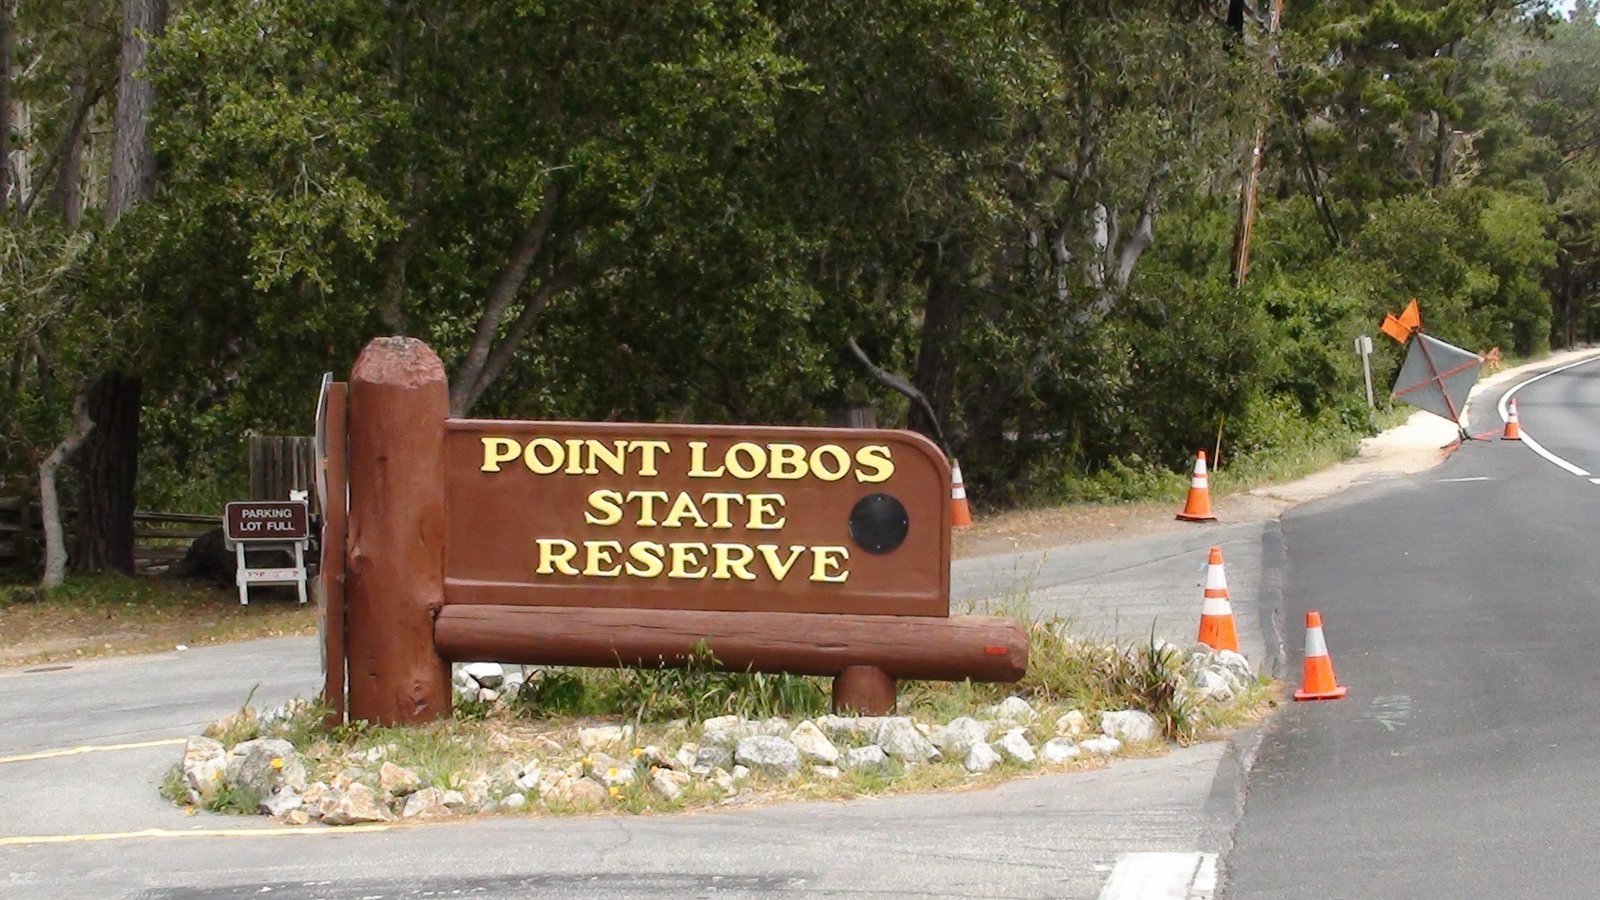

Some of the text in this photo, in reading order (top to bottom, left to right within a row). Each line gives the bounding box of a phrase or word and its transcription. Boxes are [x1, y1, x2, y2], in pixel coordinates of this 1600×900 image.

[480, 437, 895, 483] POINT LOBOS
[240, 522, 296, 531] LOT FULL
[242, 509, 292, 518] PARKING
[584, 489, 786, 530] STATE
[535, 538, 850, 583] RESERVE
